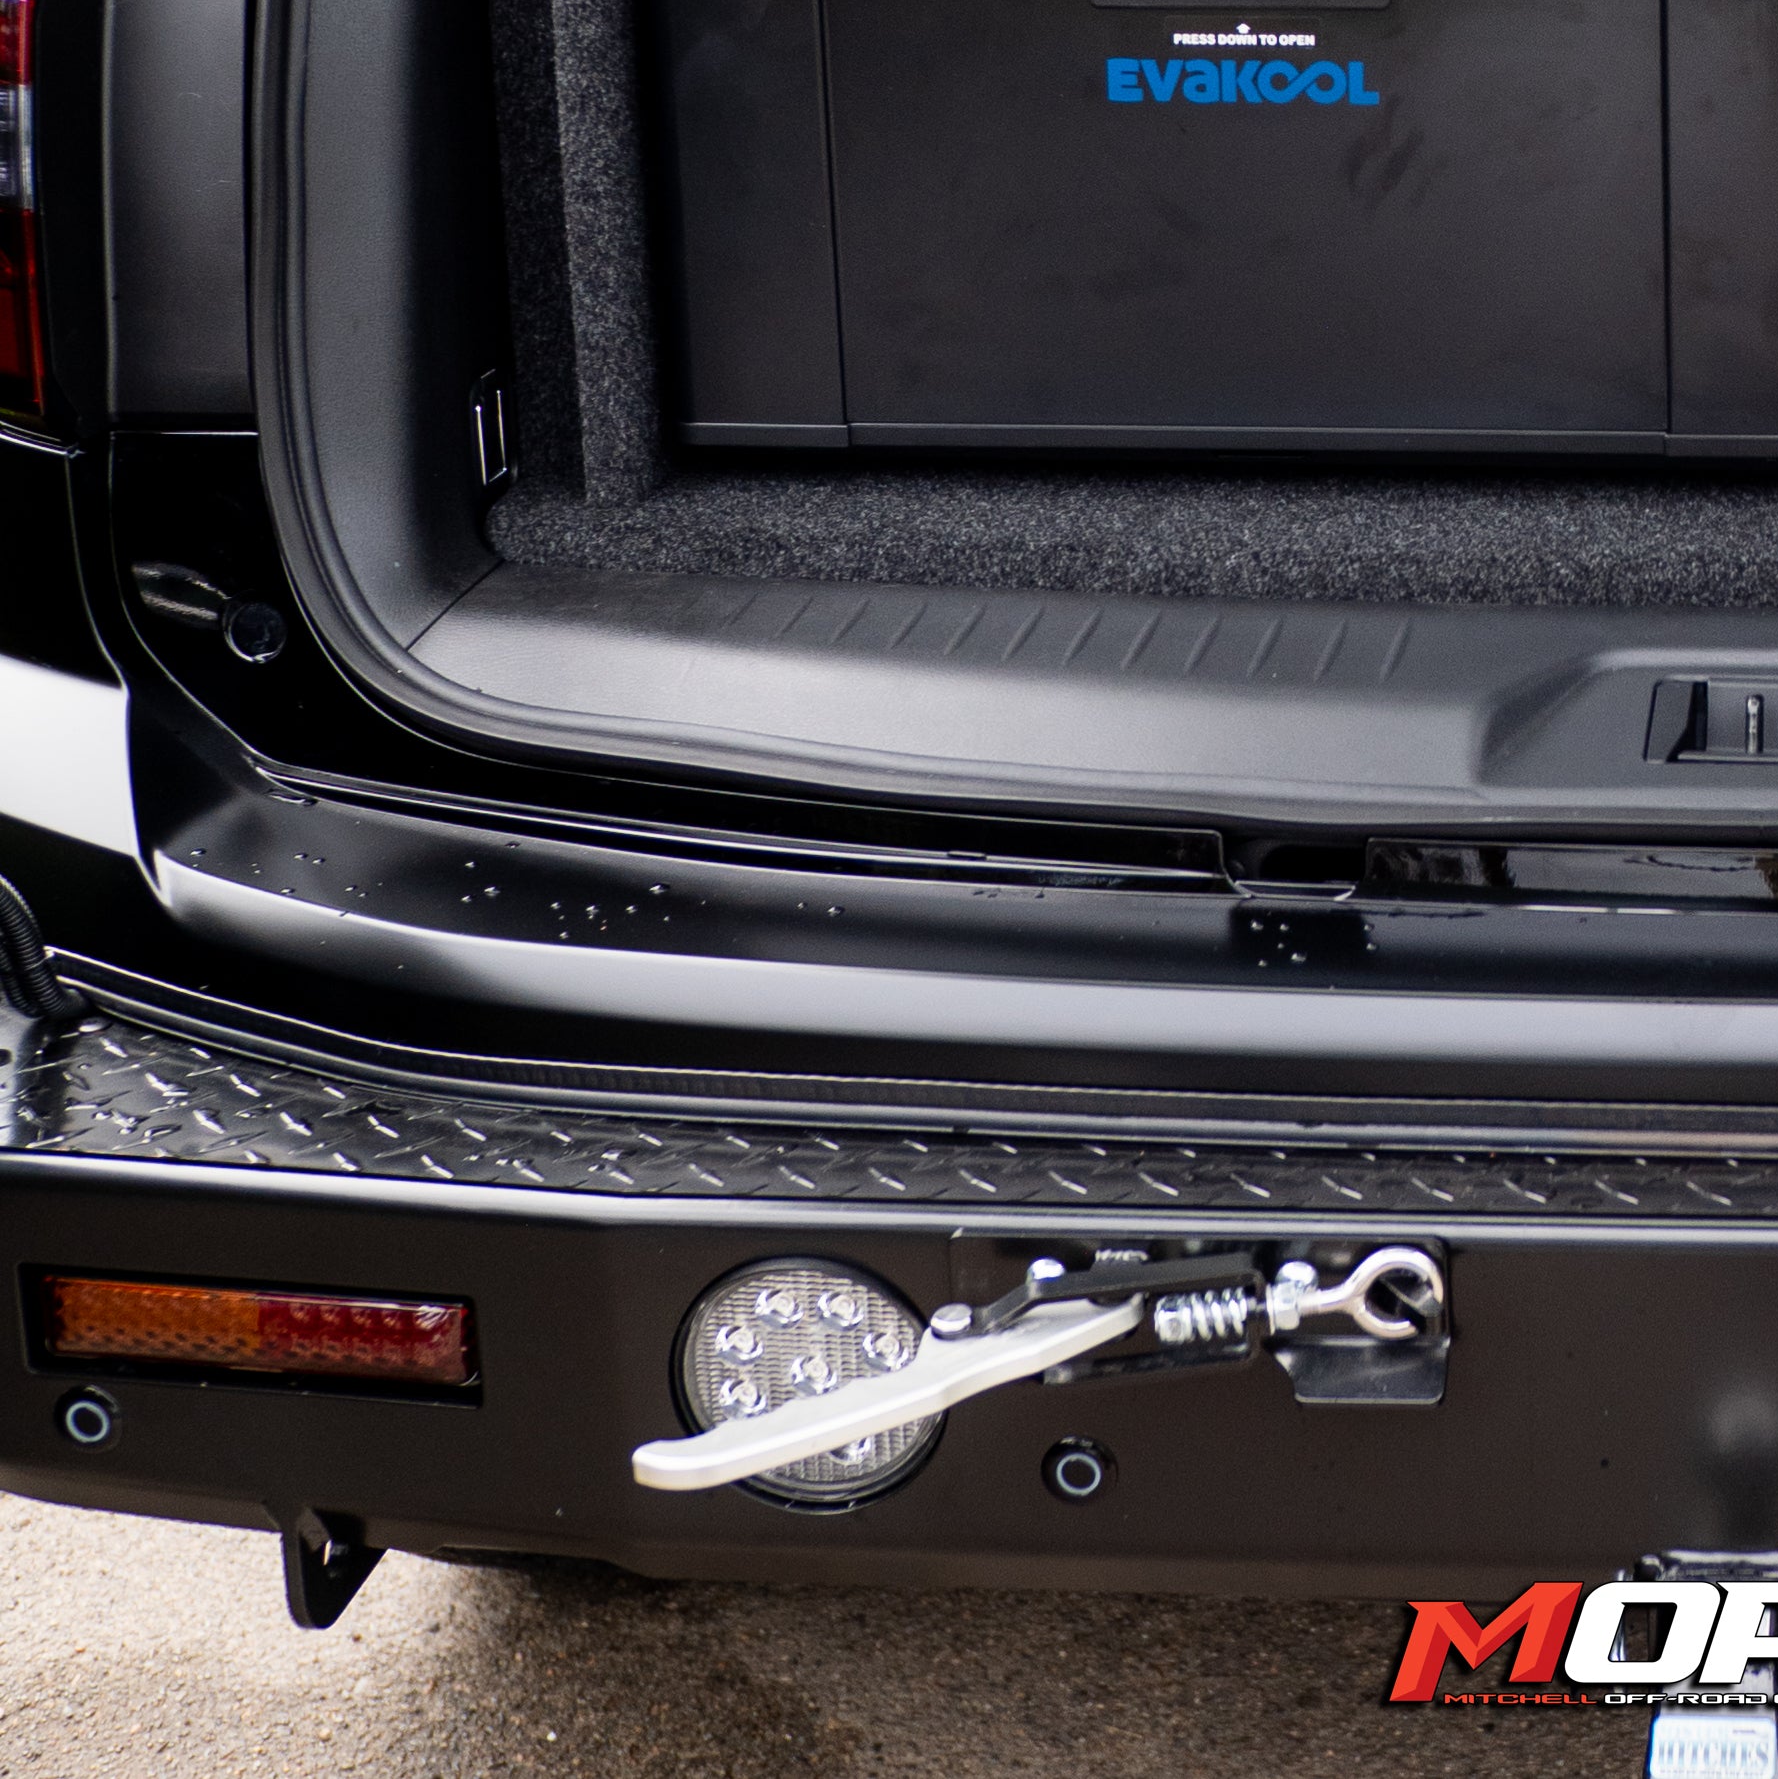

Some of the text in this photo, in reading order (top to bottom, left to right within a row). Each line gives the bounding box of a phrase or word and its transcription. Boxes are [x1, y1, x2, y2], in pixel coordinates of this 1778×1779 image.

[1173, 33, 1315, 46] PRESS DOWN TO OPEN
